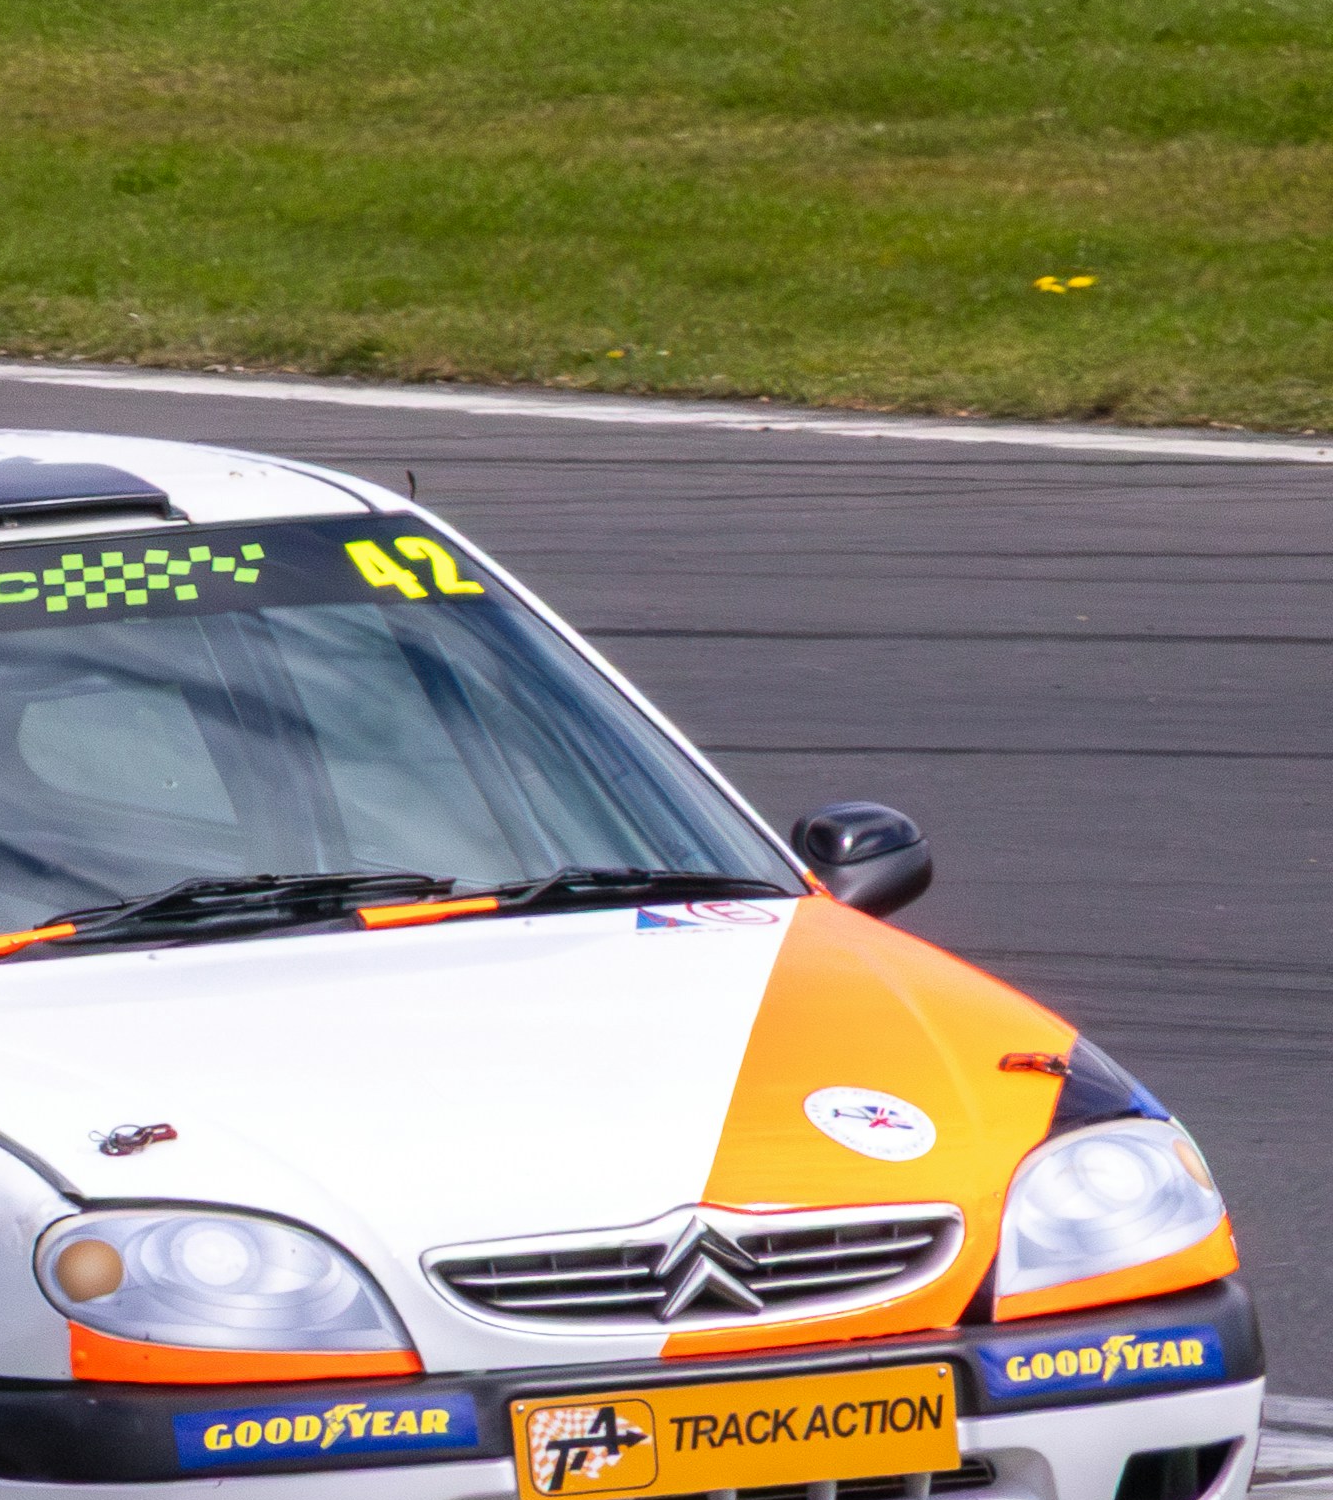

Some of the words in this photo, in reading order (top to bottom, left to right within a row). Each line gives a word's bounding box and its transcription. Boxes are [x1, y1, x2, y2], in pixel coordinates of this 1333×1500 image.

[345, 535, 485, 599] 42
[669, 1406, 798, 1452] TRACK
[801, 1393, 944, 1442] ACTION
